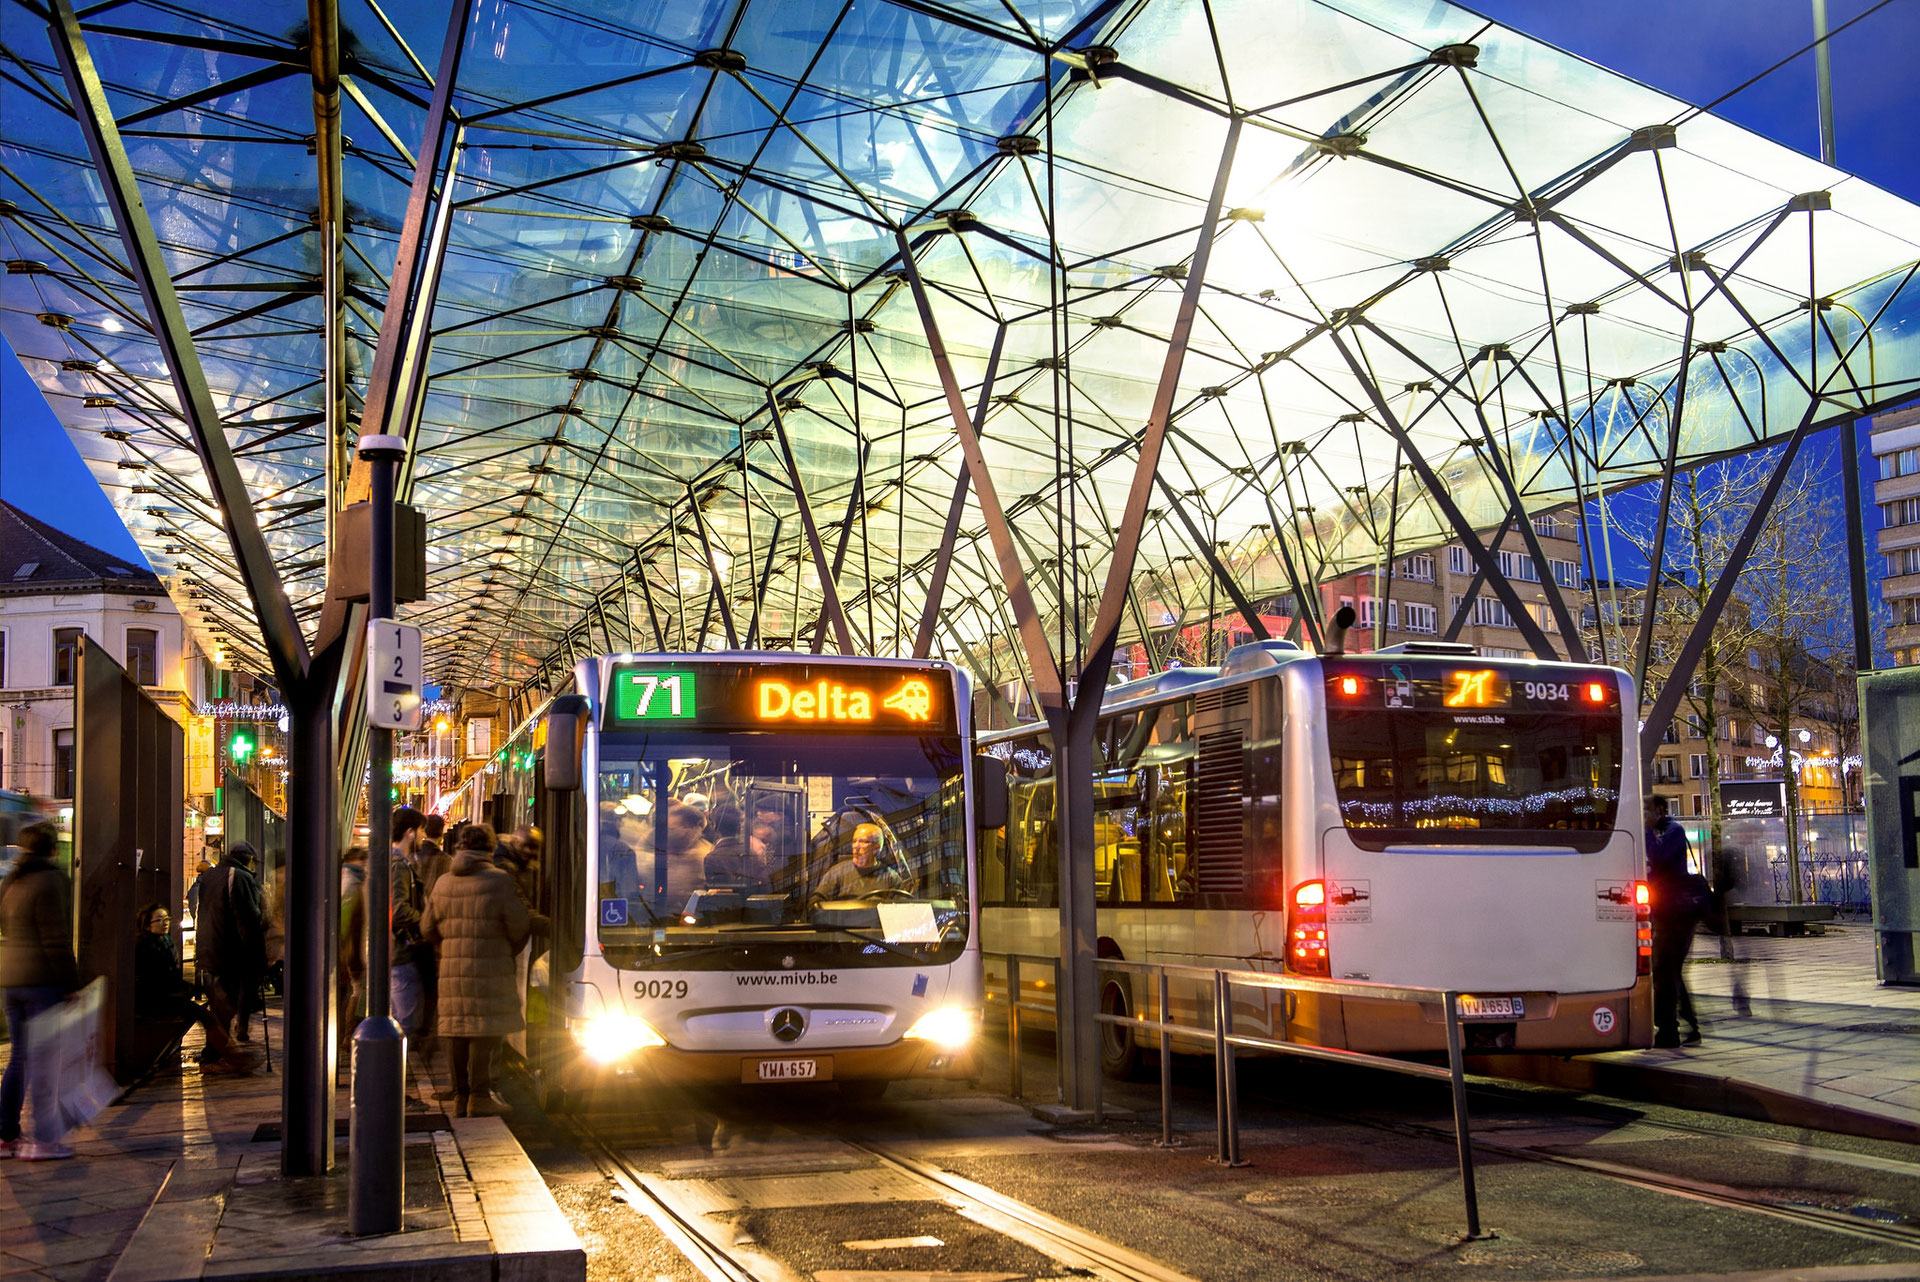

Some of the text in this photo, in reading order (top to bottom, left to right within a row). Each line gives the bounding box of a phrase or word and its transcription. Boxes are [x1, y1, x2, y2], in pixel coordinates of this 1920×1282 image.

[395, 628, 402, 649] 1
[394, 656, 403, 678] 2
[631, 675, 872, 719] 71 Delta
[1452, 671, 1570, 704] 71 9034
[393, 700, 403, 722] 3
[1453, 714, 1506, 725] www.stib.be
[633, 972, 838, 999] 9029 www.mivb.be
[1595, 1011, 1612, 1025] 75
